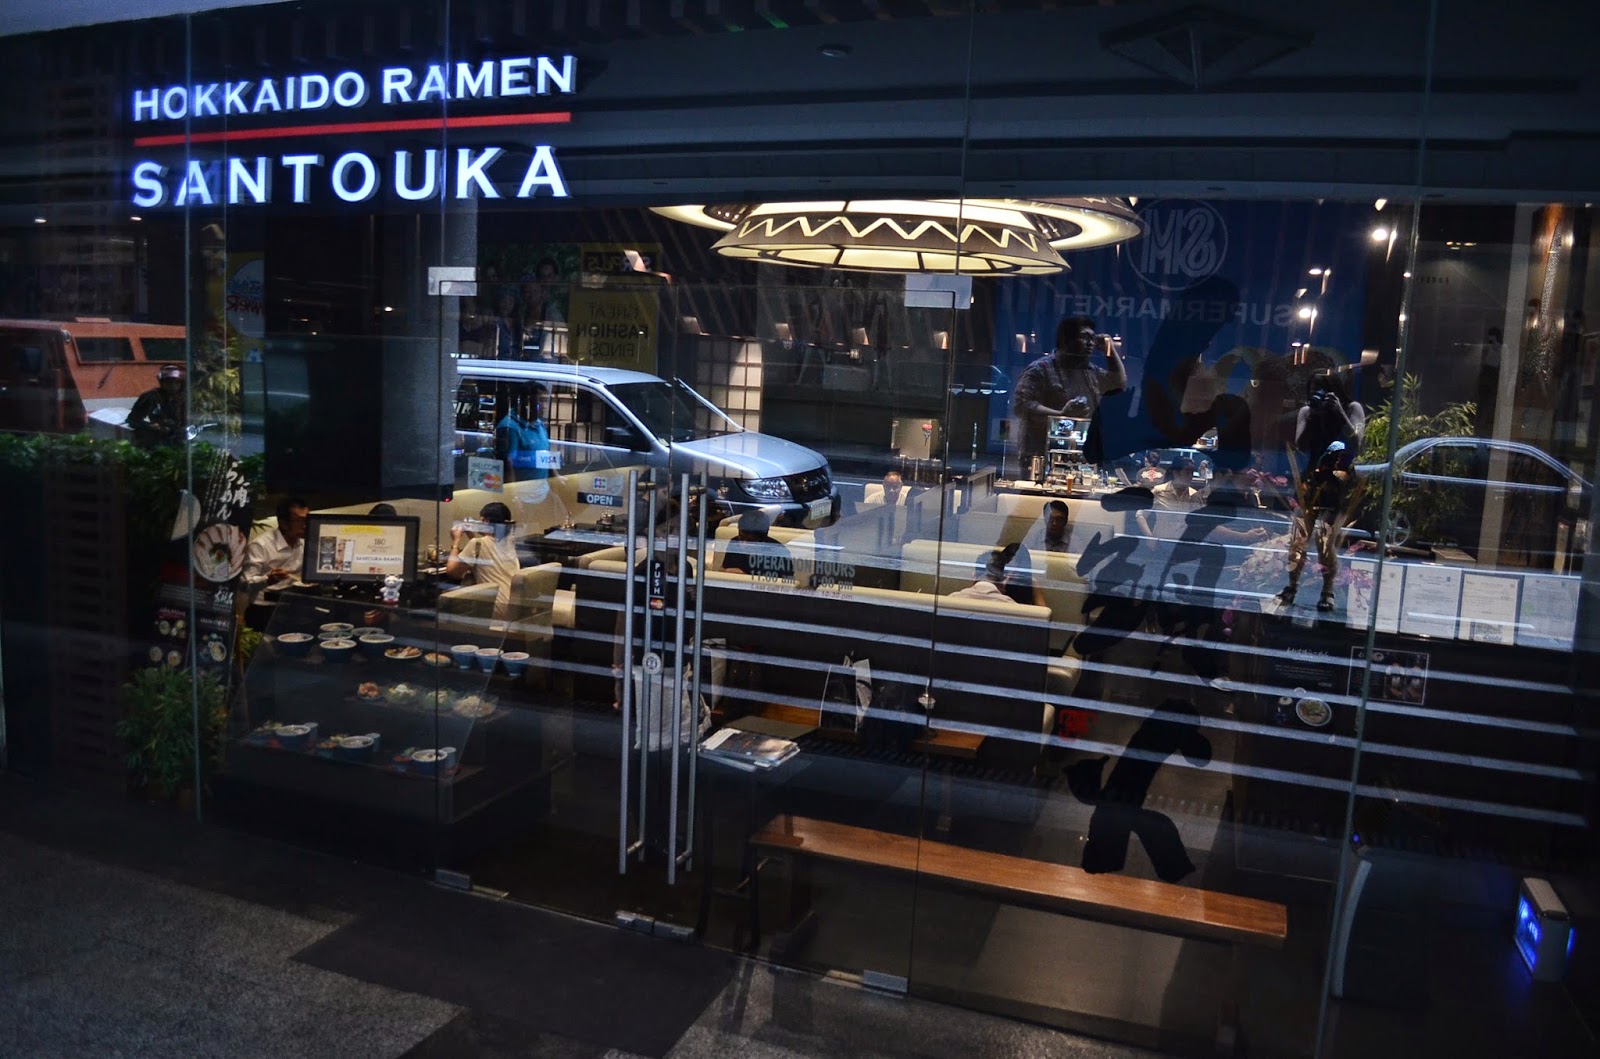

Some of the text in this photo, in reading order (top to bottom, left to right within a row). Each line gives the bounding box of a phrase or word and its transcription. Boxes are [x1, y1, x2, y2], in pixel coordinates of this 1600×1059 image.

[133, 54, 576, 122] HOKKAIDO RAMEN
[132, 145, 571, 208] SANTOUKA
[541, 456, 557, 464] VISA
[586, 494, 613, 506] OPEN
[653, 562, 661, 595] PUSH
[748, 554, 856, 578] OPERATION HOURS
